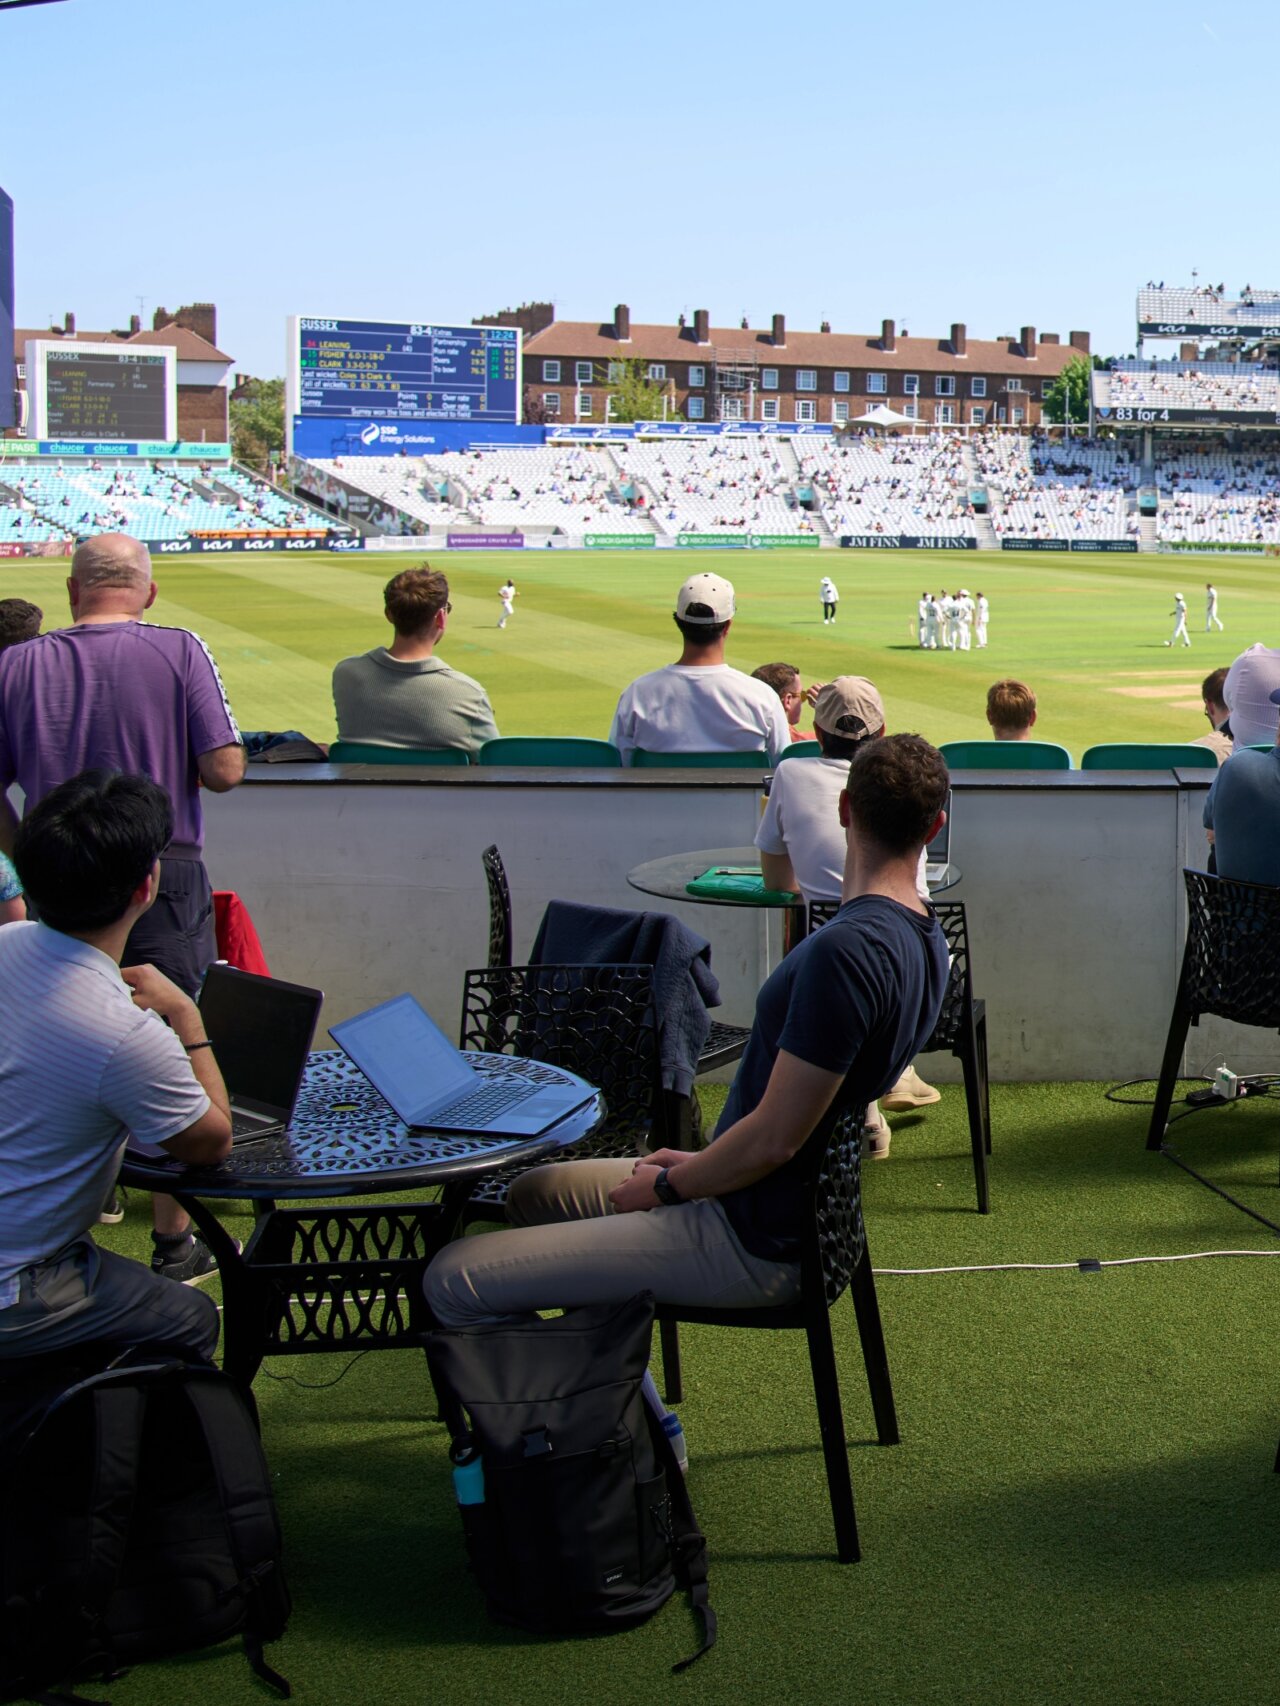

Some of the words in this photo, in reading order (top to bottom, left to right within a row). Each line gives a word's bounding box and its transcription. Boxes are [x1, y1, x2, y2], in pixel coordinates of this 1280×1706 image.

[301, 320, 338, 330] SUSSEX
[1158, 325, 1186, 334] KIA
[410, 325, 432, 336] 83-4
[1210, 326, 1238, 335] KIA
[319, 341, 351, 349] LEANING
[433, 339, 467, 347] Partnership
[48, 352, 79, 361] SUSSEX
[319, 360, 342, 368] CLARK
[1116, 408, 1133, 420] 83
[1137, 408, 1156, 420] for
[1160, 409, 1169, 421] 4
[381, 426, 398, 434] sse
[11, 443, 36, 452] PASS
[50, 444, 85, 453] chaucer
[94, 444, 128, 454] chaucer
[161, 542, 191, 551] KIA
[203, 541, 232, 550] KIA
[244, 540, 274, 549] KIA
[286, 539, 315, 548] KIA
[849, 536, 867, 548] JM
[870, 536, 899, 548] FINN
[917, 537, 935, 548] JM
[938, 537, 967, 549] FINN
